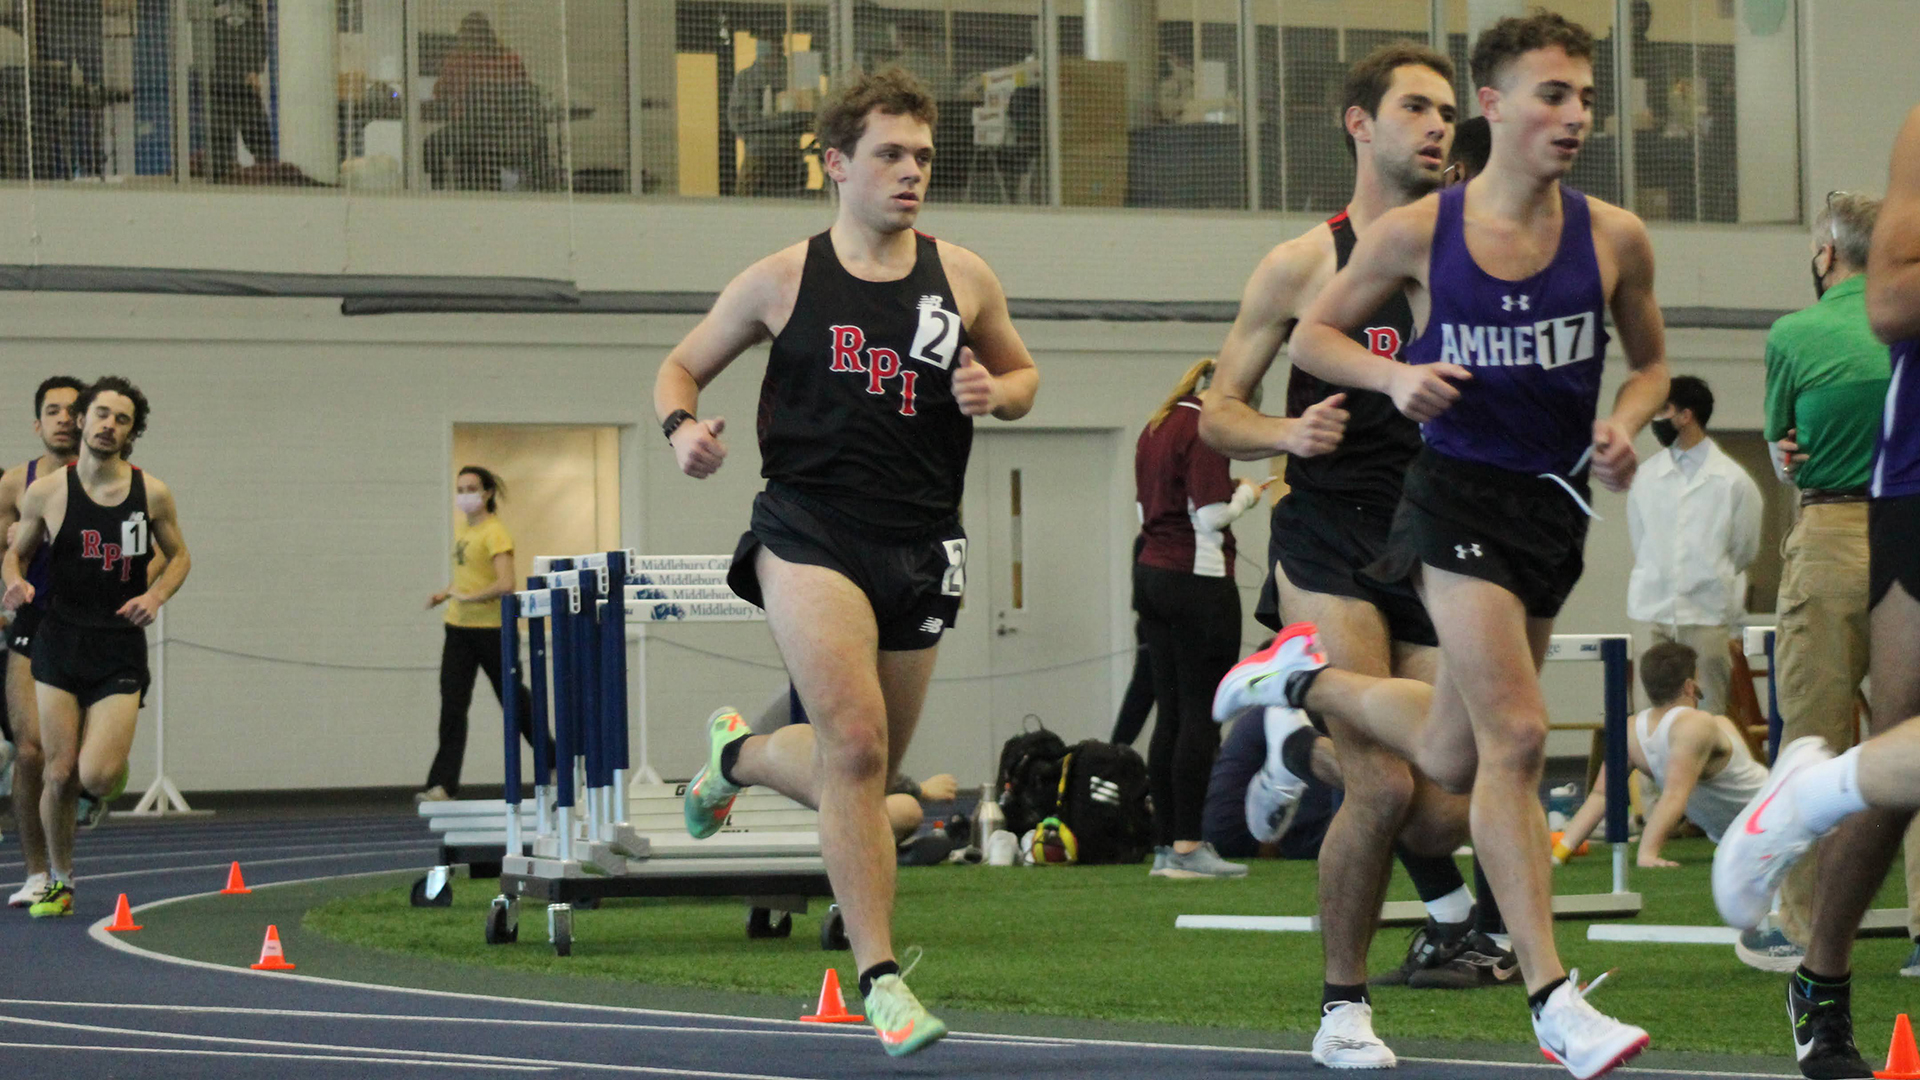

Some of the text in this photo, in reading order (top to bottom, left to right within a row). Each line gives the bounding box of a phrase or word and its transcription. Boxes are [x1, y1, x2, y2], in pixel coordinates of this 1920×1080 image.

[921, 311, 949, 364] 2
[1440, 323, 1541, 366] AMHE
[1541, 316, 1585, 365] 17
[829, 325, 919, 416] RPI
[81, 529, 131, 581] RPI
[130, 524, 140, 553] 1
[641, 559, 733, 571] Middlebury Coll
[659, 574, 723, 586] Middlebury
[949, 543, 962, 592] 2
[690, 604, 753, 619] Middlebury
